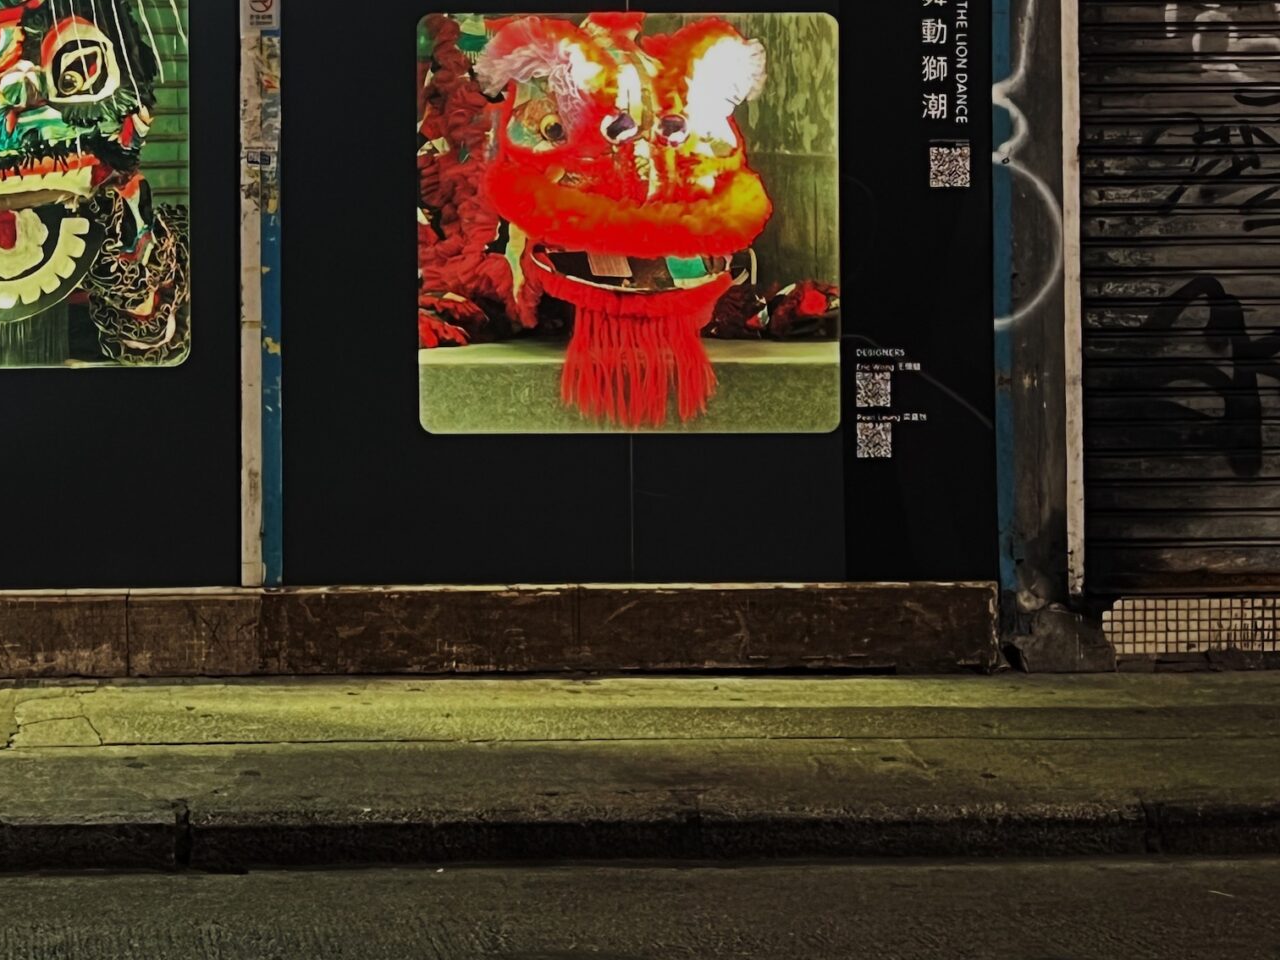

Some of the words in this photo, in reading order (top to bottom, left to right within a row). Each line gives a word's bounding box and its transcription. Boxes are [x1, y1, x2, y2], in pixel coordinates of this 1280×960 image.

[954, 0, 969, 30] THE
[954, 32, 969, 69] LION
[954, 72, 969, 125] DANCE
[856, 348, 906, 357] DESIGNERS
